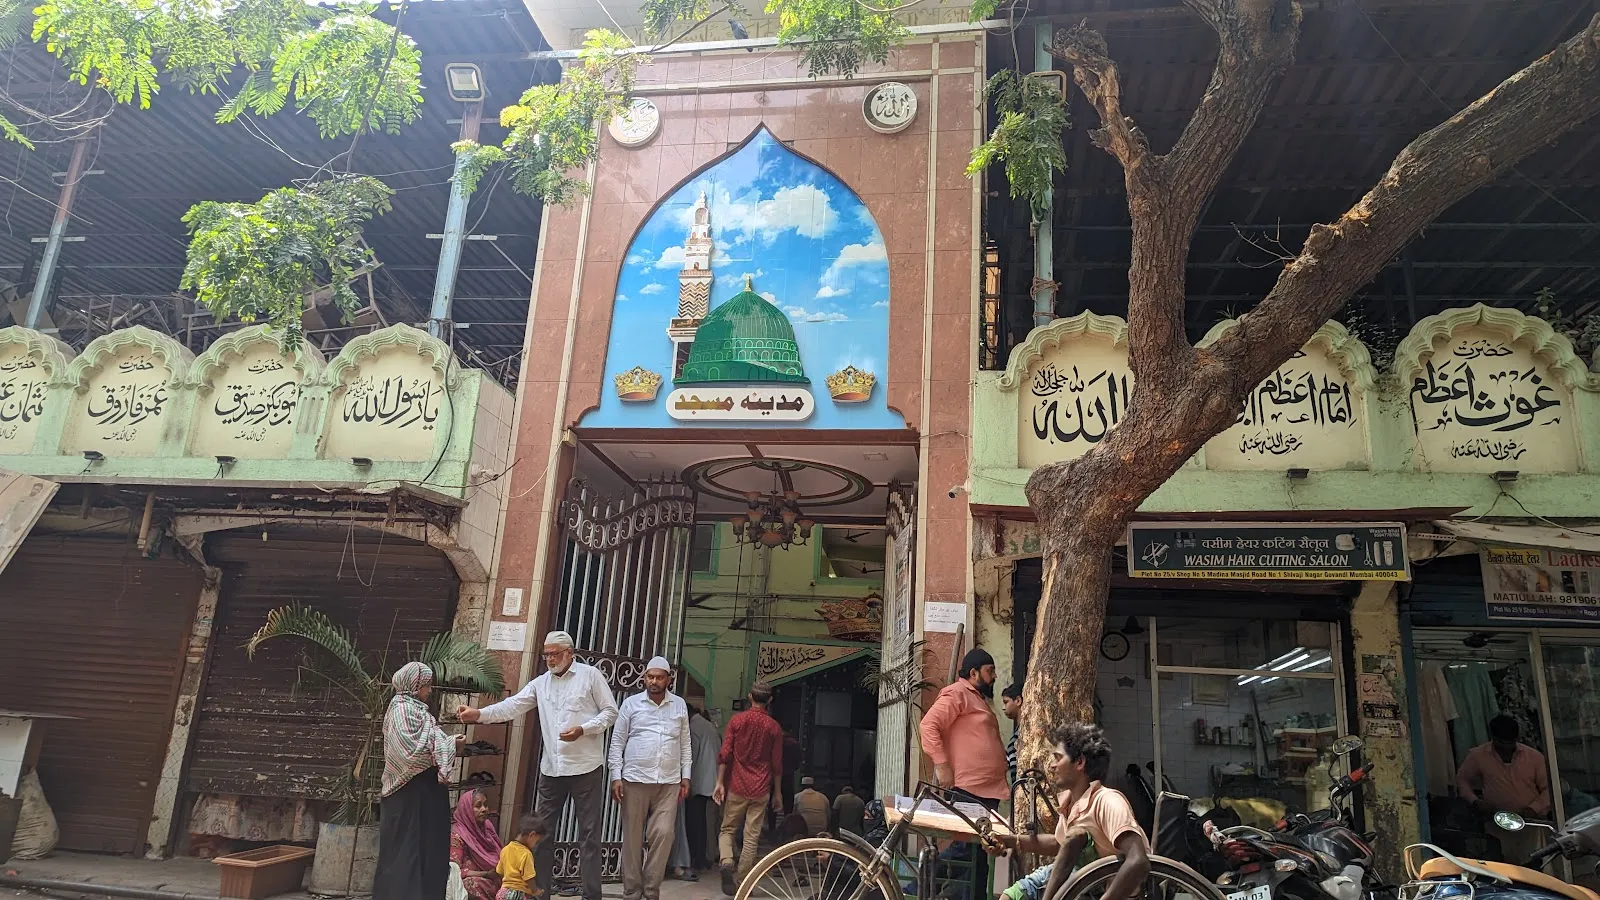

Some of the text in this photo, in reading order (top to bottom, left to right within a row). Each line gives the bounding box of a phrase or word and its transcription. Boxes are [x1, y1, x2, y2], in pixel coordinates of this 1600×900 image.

[674, 394, 735, 415] مسجد
[1201, 536, 1329, 552] वसीम हेयर कटिंग सैलून
[1184, 554, 1349, 566] WASIM HAIR CUTTING SALON
[1559, 595, 1600, 605] 981906
